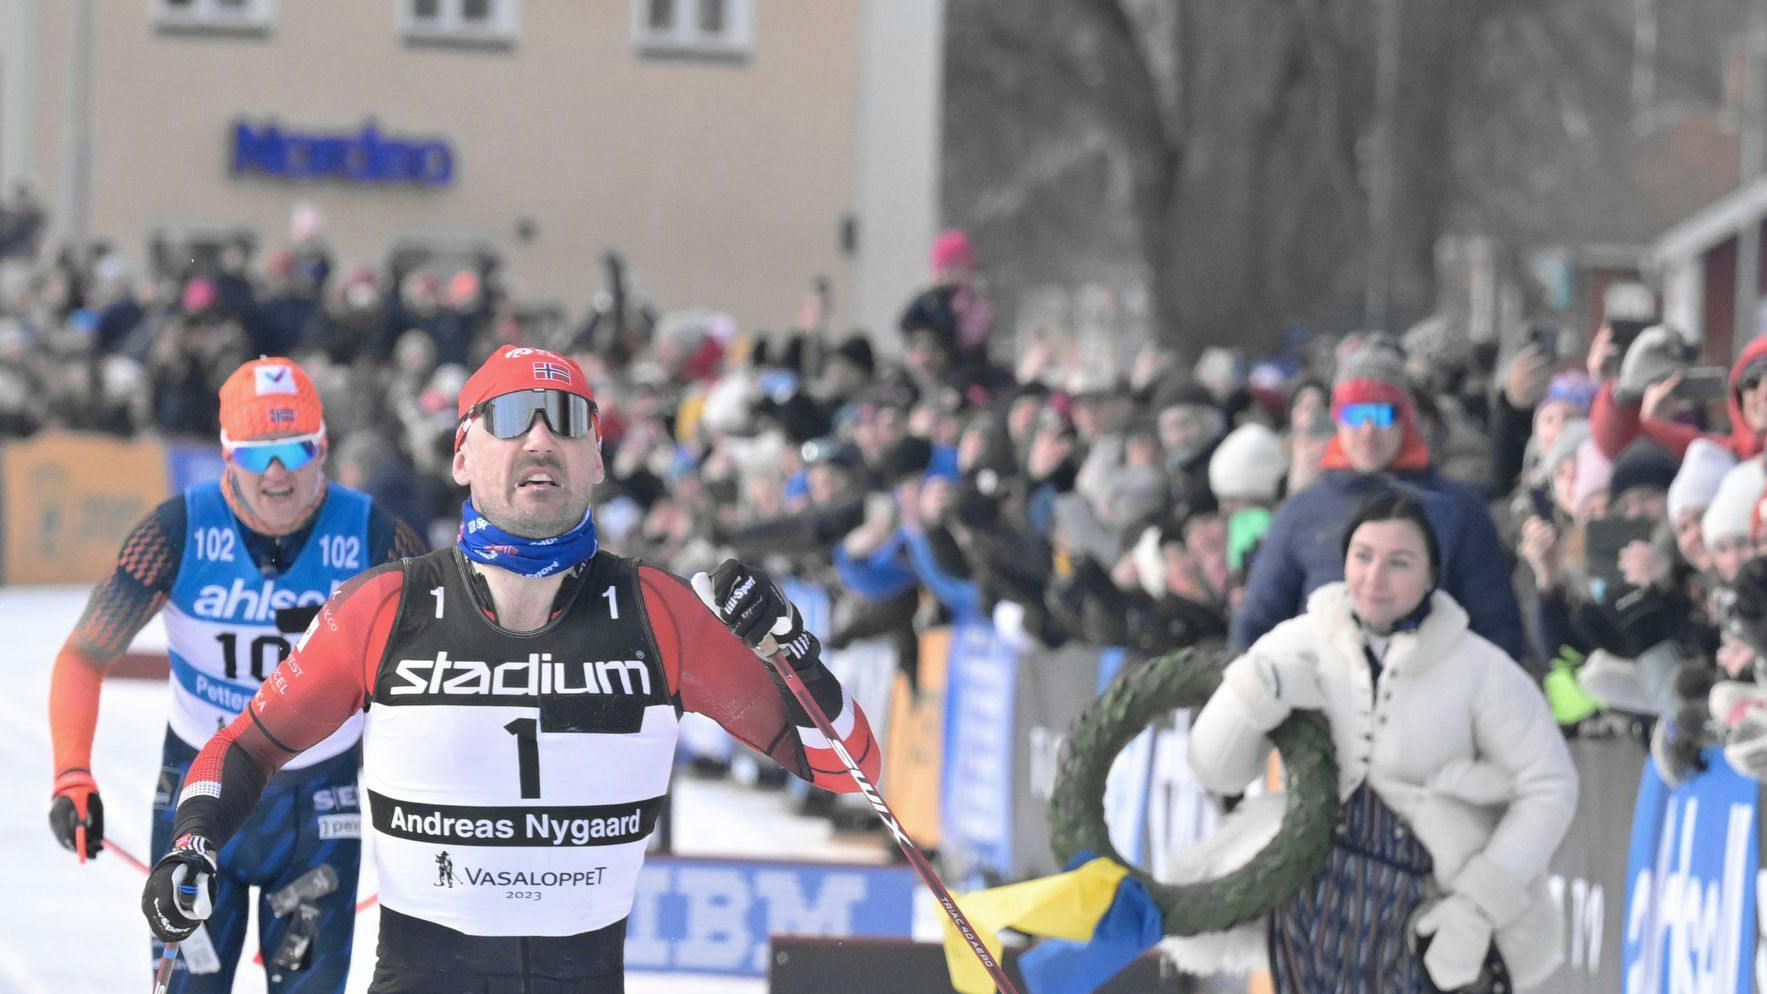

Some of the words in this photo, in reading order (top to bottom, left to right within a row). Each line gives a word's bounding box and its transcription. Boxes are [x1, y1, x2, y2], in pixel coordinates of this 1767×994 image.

[194, 527, 235, 562] 102
[319, 534, 360, 569] 102
[193, 577, 341, 621] ahls
[430, 586, 444, 619] 1
[602, 585, 619, 620] 1
[215, 632, 293, 683] 10
[390, 651, 651, 696] stadium
[503, 717, 541, 800] 1
[827, 736, 915, 849] SWIX
[390, 806, 514, 839] Andreas
[525, 809, 641, 845] Nygaard
[464, 867, 608, 886] VASALOPPET
[505, 891, 542, 902] 2023
[624, 864, 867, 976] IBM
[938, 894, 965, 927] TRIAC
[968, 938, 994, 969] AERO
